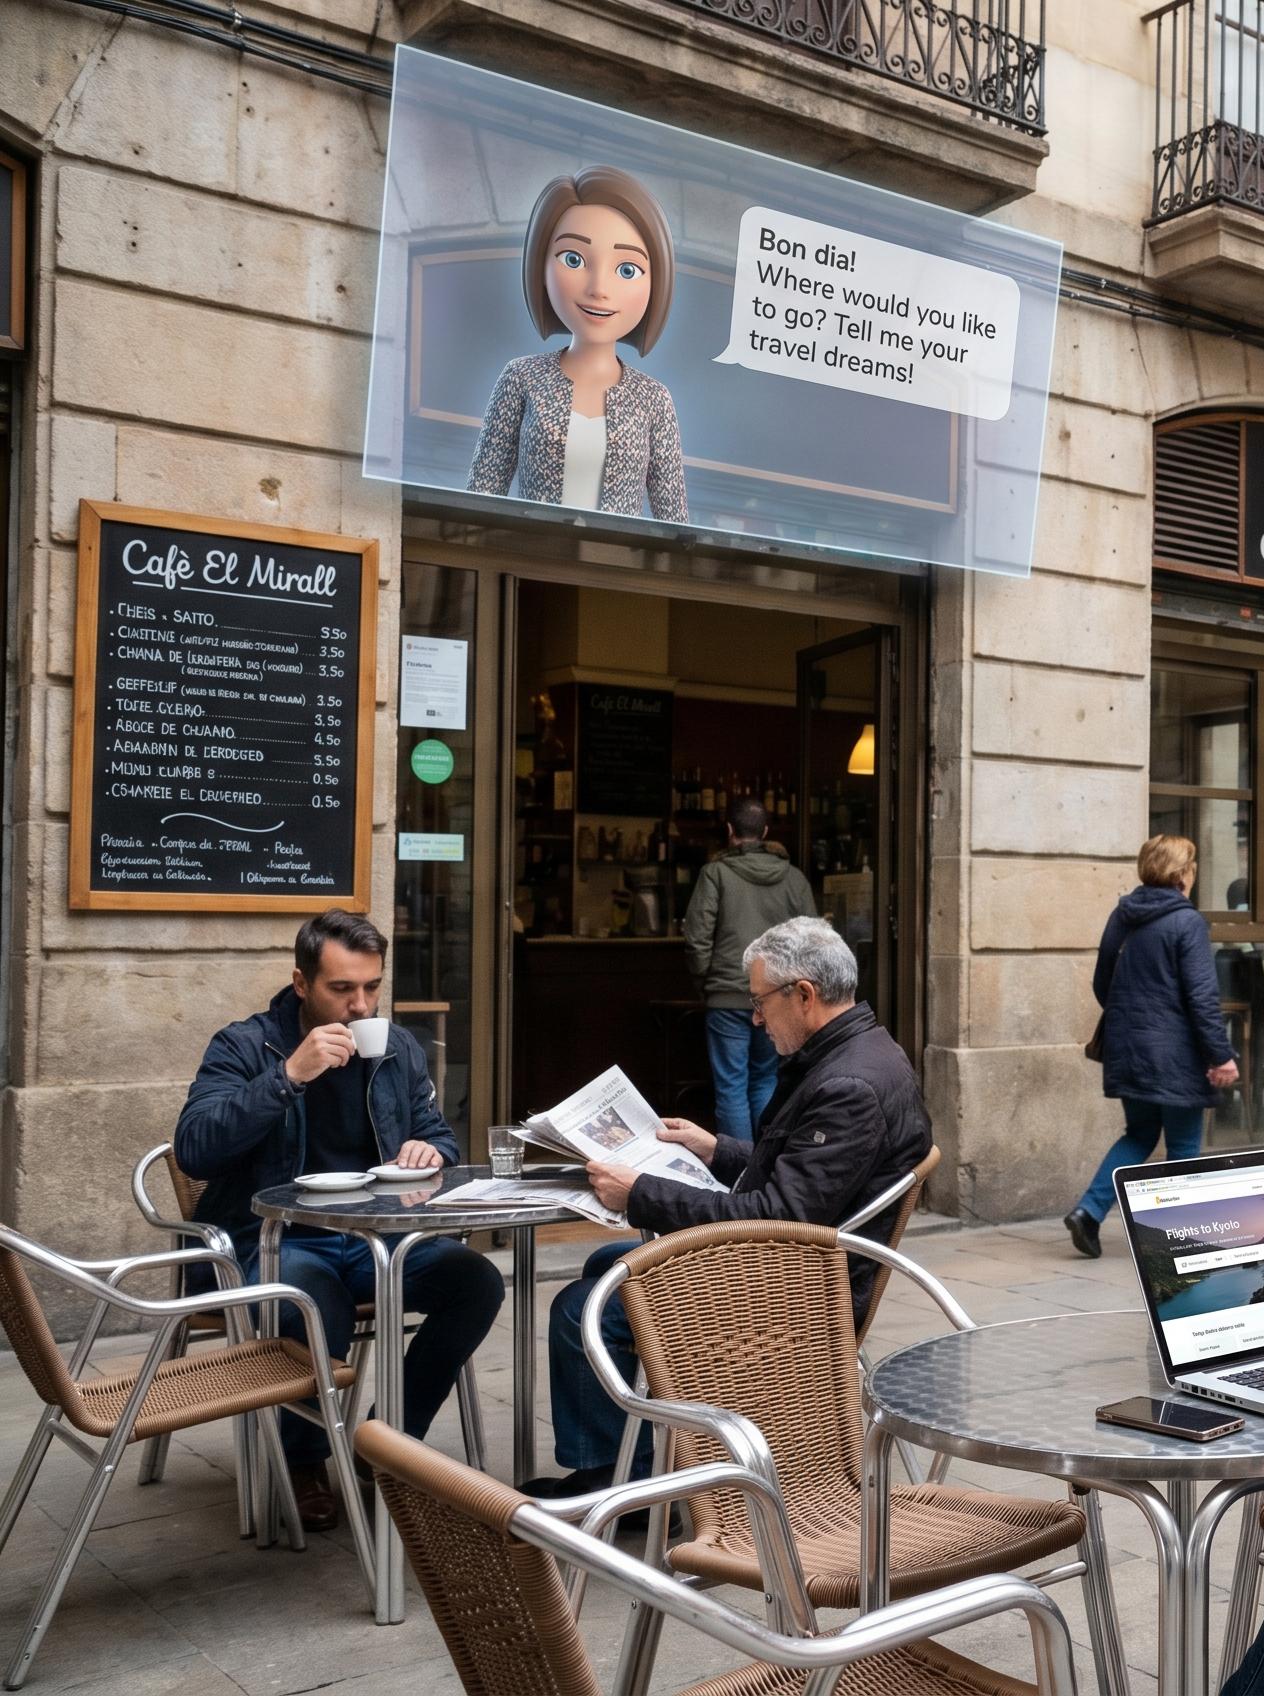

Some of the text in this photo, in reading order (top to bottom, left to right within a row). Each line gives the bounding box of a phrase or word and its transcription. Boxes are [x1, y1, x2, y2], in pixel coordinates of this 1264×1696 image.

[759, 227, 857, 272] Bon dia!
[756, 260, 997, 339] Where would you like
[749, 329, 914, 384] travel dreams!
[752, 296, 968, 363] to go? Tell me your
[122, 539, 338, 597] Cafè El Mirall
[1166, 1224, 1200, 1241] Flights
[1200, 1223, 1212, 1235] to
